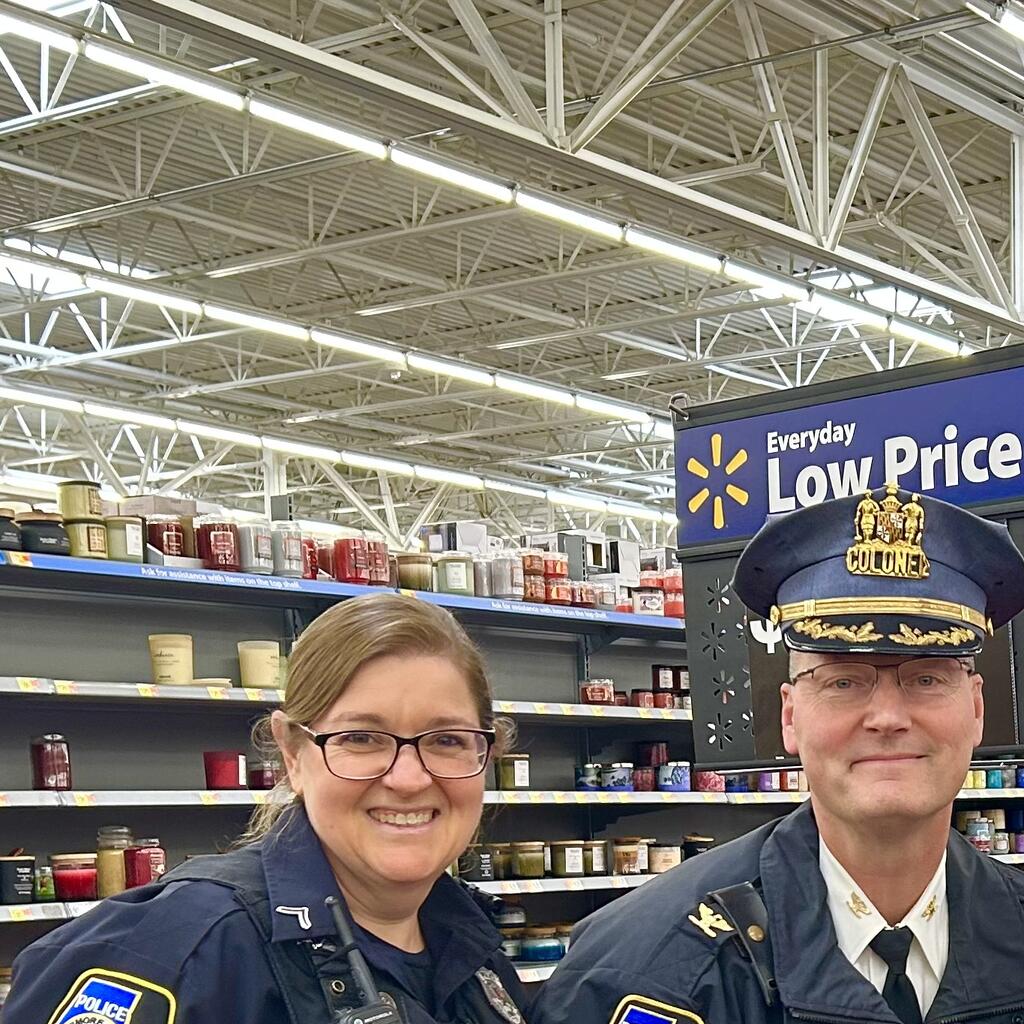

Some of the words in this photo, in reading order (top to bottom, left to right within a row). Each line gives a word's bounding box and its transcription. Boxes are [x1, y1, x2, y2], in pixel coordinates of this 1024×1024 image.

[767, 421, 856, 454] Everyday
[768, 455, 872, 514] Low
[884, 424, 1023, 492] Price
[846, 547, 929, 578] COLONEL
[74, 994, 129, 1022] POLICE
